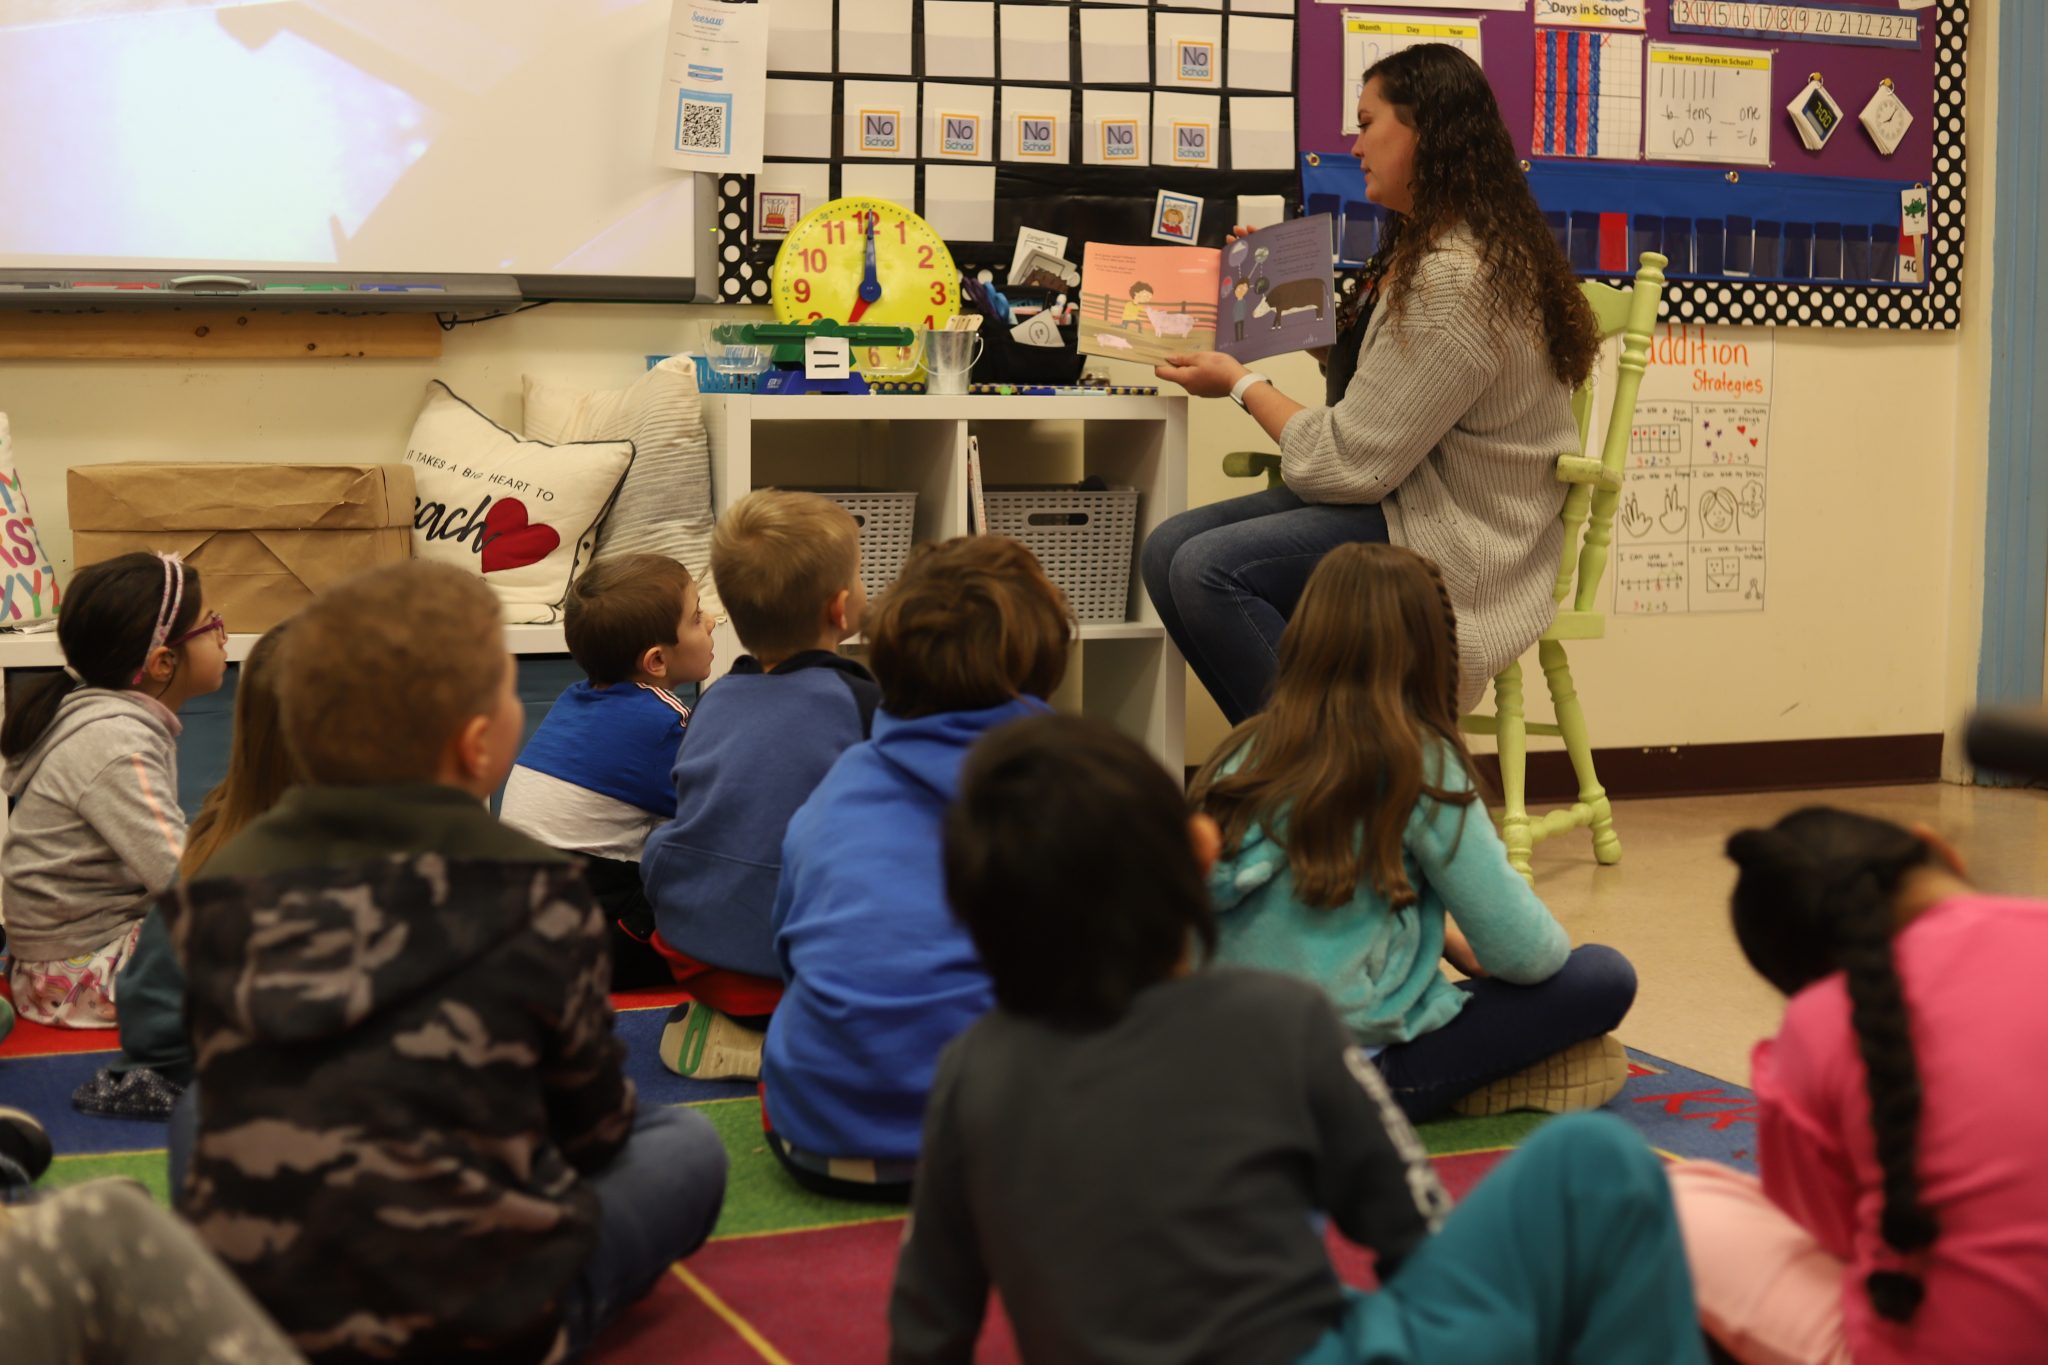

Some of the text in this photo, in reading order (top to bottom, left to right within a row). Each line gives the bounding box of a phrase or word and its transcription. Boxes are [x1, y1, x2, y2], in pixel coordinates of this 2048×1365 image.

[1552, 2, 1628, 17] Days in School
[1677, 1, 1913, 39] 13 14 15 16 17 18 19 20 21 22 23 24
[1358, 23, 1382, 32] Month
[1406, 26, 1420, 34] Day
[1183, 46, 1208, 66] No
[1685, 55, 1703, 63] Many
[1704, 57, 1720, 65] Days
[1181, 66, 1209, 77] School
[1685, 103, 1712, 124] tens
[1740, 105, 1761, 121] one
[865, 115, 894, 136] No
[947, 118, 973, 140] No
[1024, 120, 1050, 141] No
[1107, 125, 1133, 145] No
[864, 136, 895, 147] School
[944, 139, 974, 151] School
[1022, 141, 1051, 152] School
[1179, 127, 1204, 148] No
[1672, 127, 1694, 149] 60
[1106, 145, 1134, 156] School
[1177, 148, 1205, 158] School
[822, 220, 846, 245] 11
[852, 210, 880, 236] 12
[895, 220, 907, 245] 1
[798, 248, 828, 273] 10
[917, 245, 934, 270] 2
[1903, 260, 1918, 273] 40
[793, 278, 811, 304] 9
[930, 280, 947, 305] 3
[1692, 368, 1764, 399] Strategies
[406, 449, 554, 502] IT TAKES A BIG HEART TO
[414, 495, 503, 554] each
